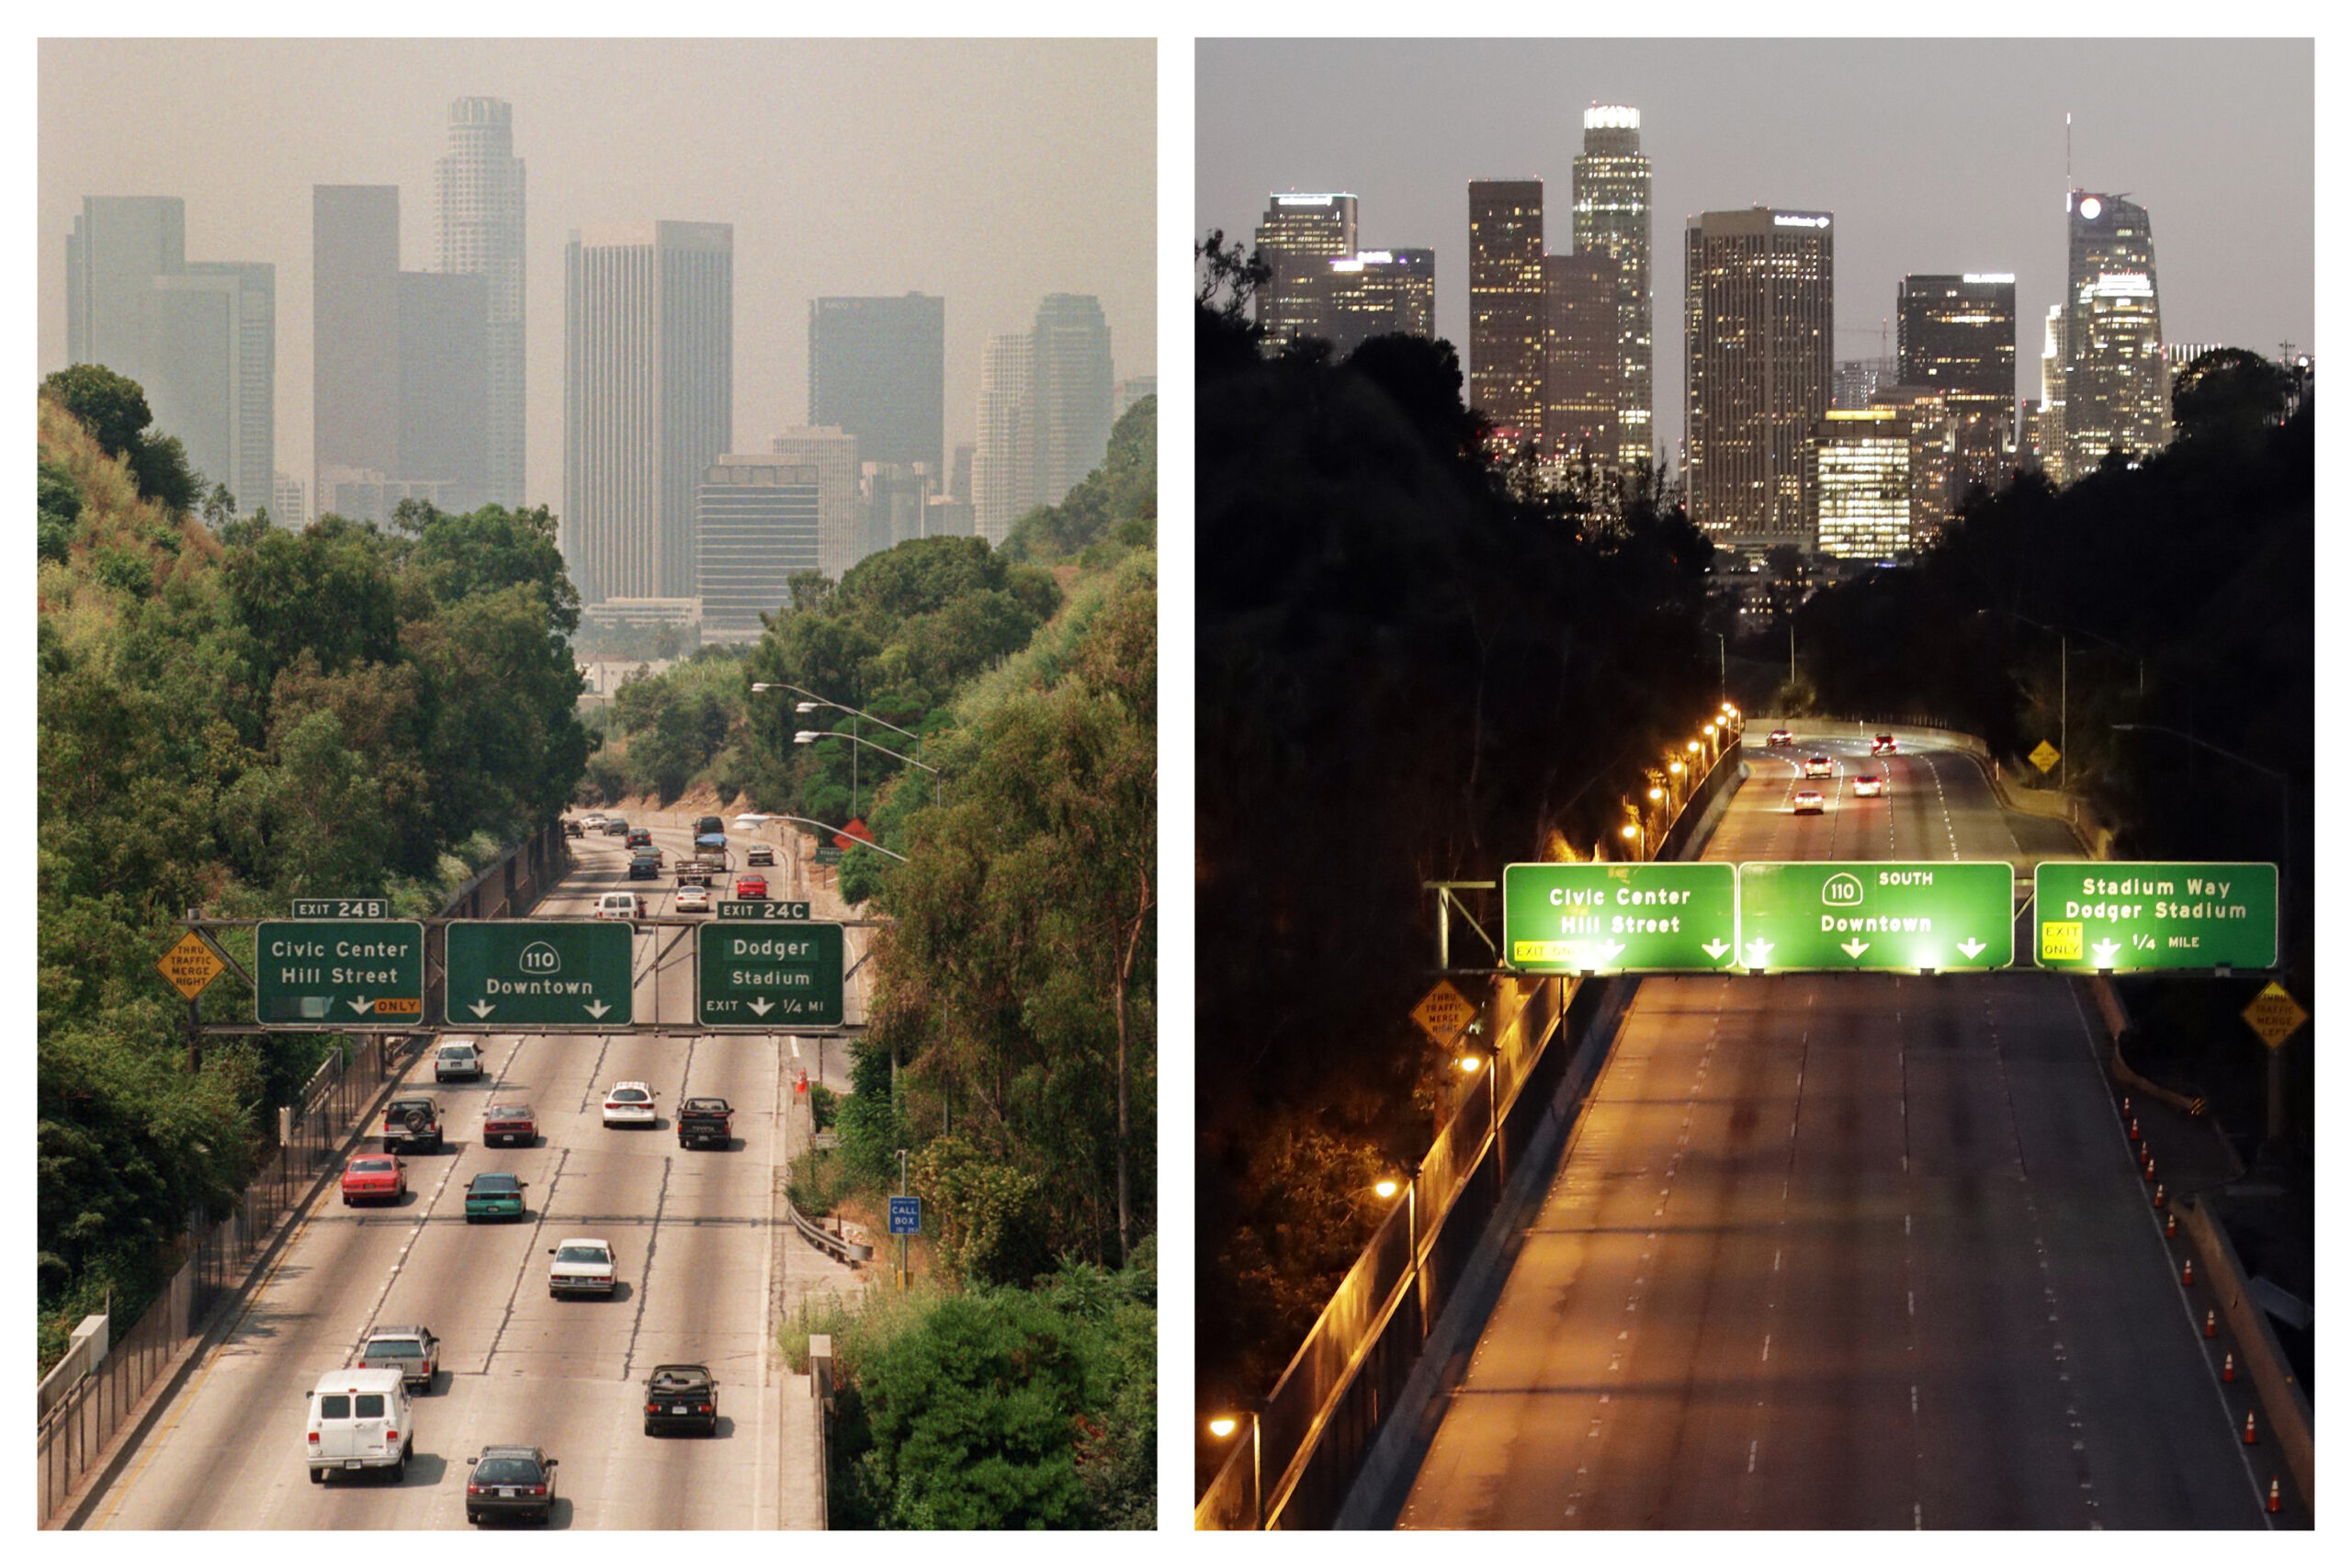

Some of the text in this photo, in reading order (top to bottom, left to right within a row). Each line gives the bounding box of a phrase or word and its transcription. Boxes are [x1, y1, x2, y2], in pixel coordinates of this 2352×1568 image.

[1879, 872, 1934, 886] SOUTH
[1831, 883, 1854, 899] 110
[2082, 878, 2231, 899] Stadium Way
[1549, 887, 1691, 906] Civic Center
[300, 902, 380, 918] EXIT 24B
[723, 903, 804, 919] EXIT 24C
[2065, 901, 2247, 923] Dodger Stadium
[1561, 916, 1680, 933] Hill Street
[1820, 915, 1932, 932] Downtown
[2045, 926, 2079, 937] EXIT
[2044, 944, 2080, 954] ONLY
[2168, 936, 2199, 948] MILE
[177, 946, 204, 954] THRU
[271, 941, 409, 958] Civic Center
[733, 939, 809, 961] Dodger
[1516, 947, 1544, 956] EXIT
[171, 956, 212, 964] TRAFFIC
[526, 952, 555, 968] 110
[175, 977, 208, 986] RIGHT
[281, 967, 398, 984] Hill Street
[732, 970, 810, 985] Stadium
[486, 978, 594, 995] Downtown
[1432, 992, 1456, 1001] THRU
[378, 1001, 417, 1011] ONLY
[706, 1000, 739, 1011] EXIT
[808, 1001, 824, 1011] MI
[1429, 1014, 1459, 1022] MERGE
[892, 1206, 917, 1214] CALL
[895, 1217, 914, 1225] BOX
